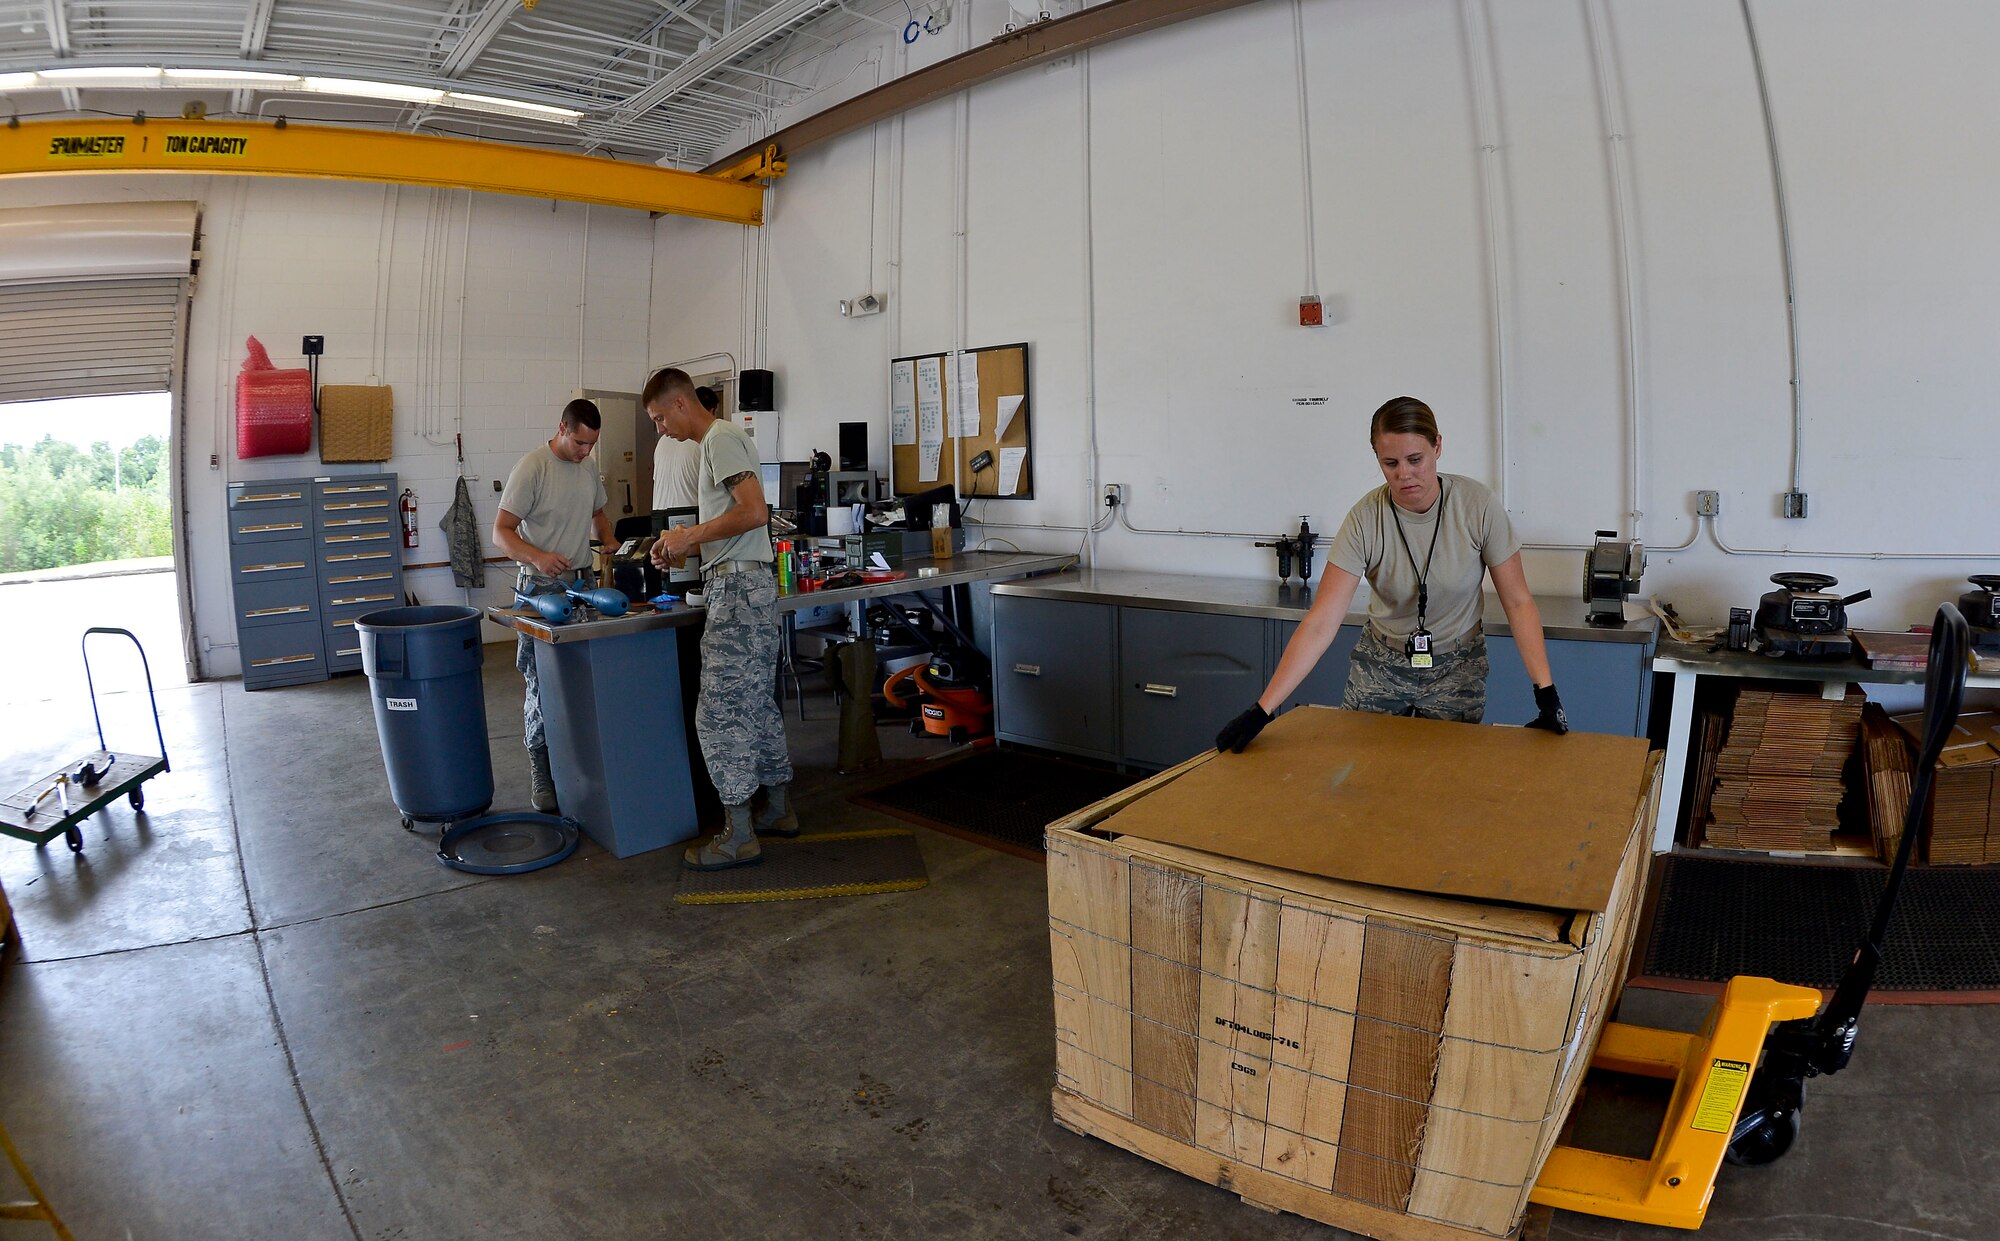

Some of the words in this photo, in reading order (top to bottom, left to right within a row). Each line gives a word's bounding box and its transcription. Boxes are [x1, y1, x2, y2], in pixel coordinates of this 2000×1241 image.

[50, 136, 124, 154] SPANMASTER
[167, 136, 188, 152] TON
[189, 136, 247, 154] CAPACITY
